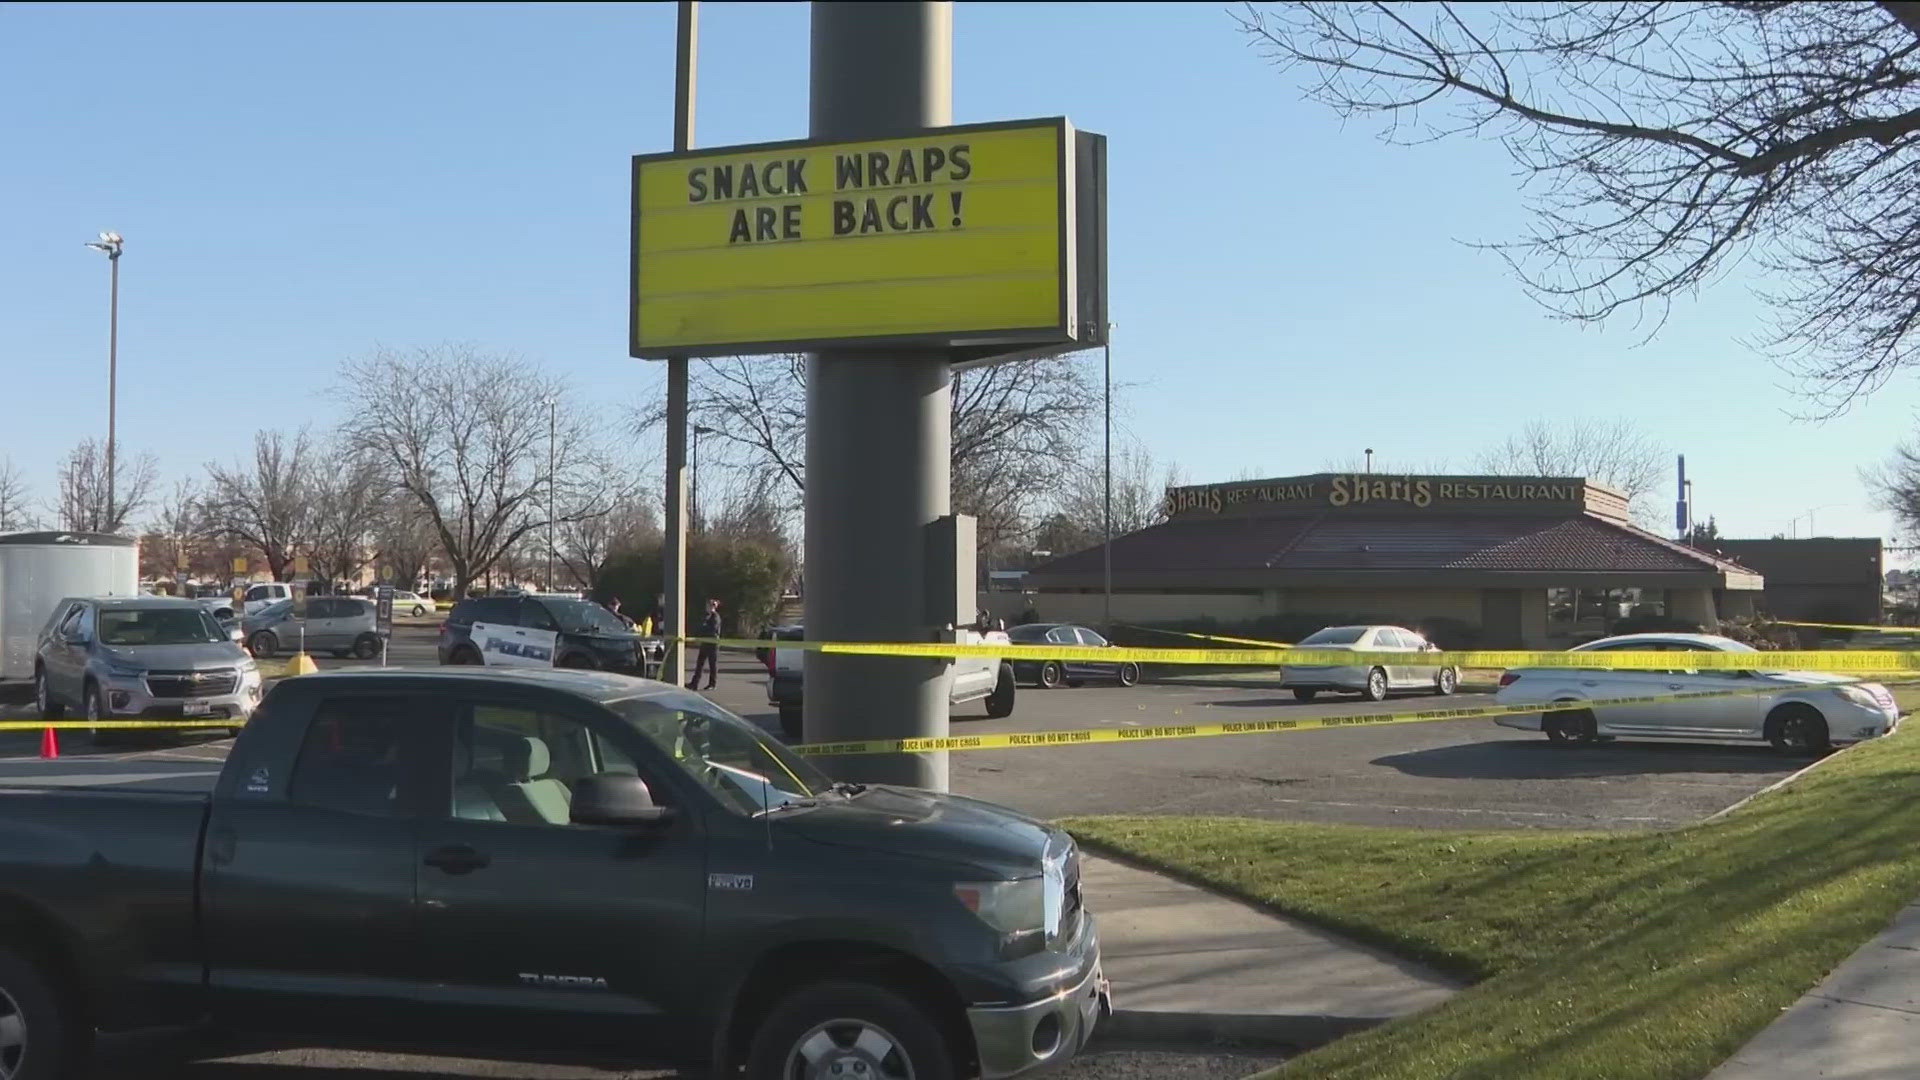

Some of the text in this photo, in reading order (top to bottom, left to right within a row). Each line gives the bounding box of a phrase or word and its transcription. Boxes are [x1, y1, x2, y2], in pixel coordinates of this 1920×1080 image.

[688, 145, 971, 202] SNACK WRAPS
[729, 205, 802, 243] ARE
[1439, 483, 1576, 500] RESTAURANT
[1009, 731, 1090, 744] POLICE LINE DO NOT CROSS
[1118, 726, 1196, 738] POLICE LINE DO NOT CROSS
[896, 737, 980, 750] POLICE LINE DO NOT CROSS
[518, 973, 609, 988] TUNDRA
